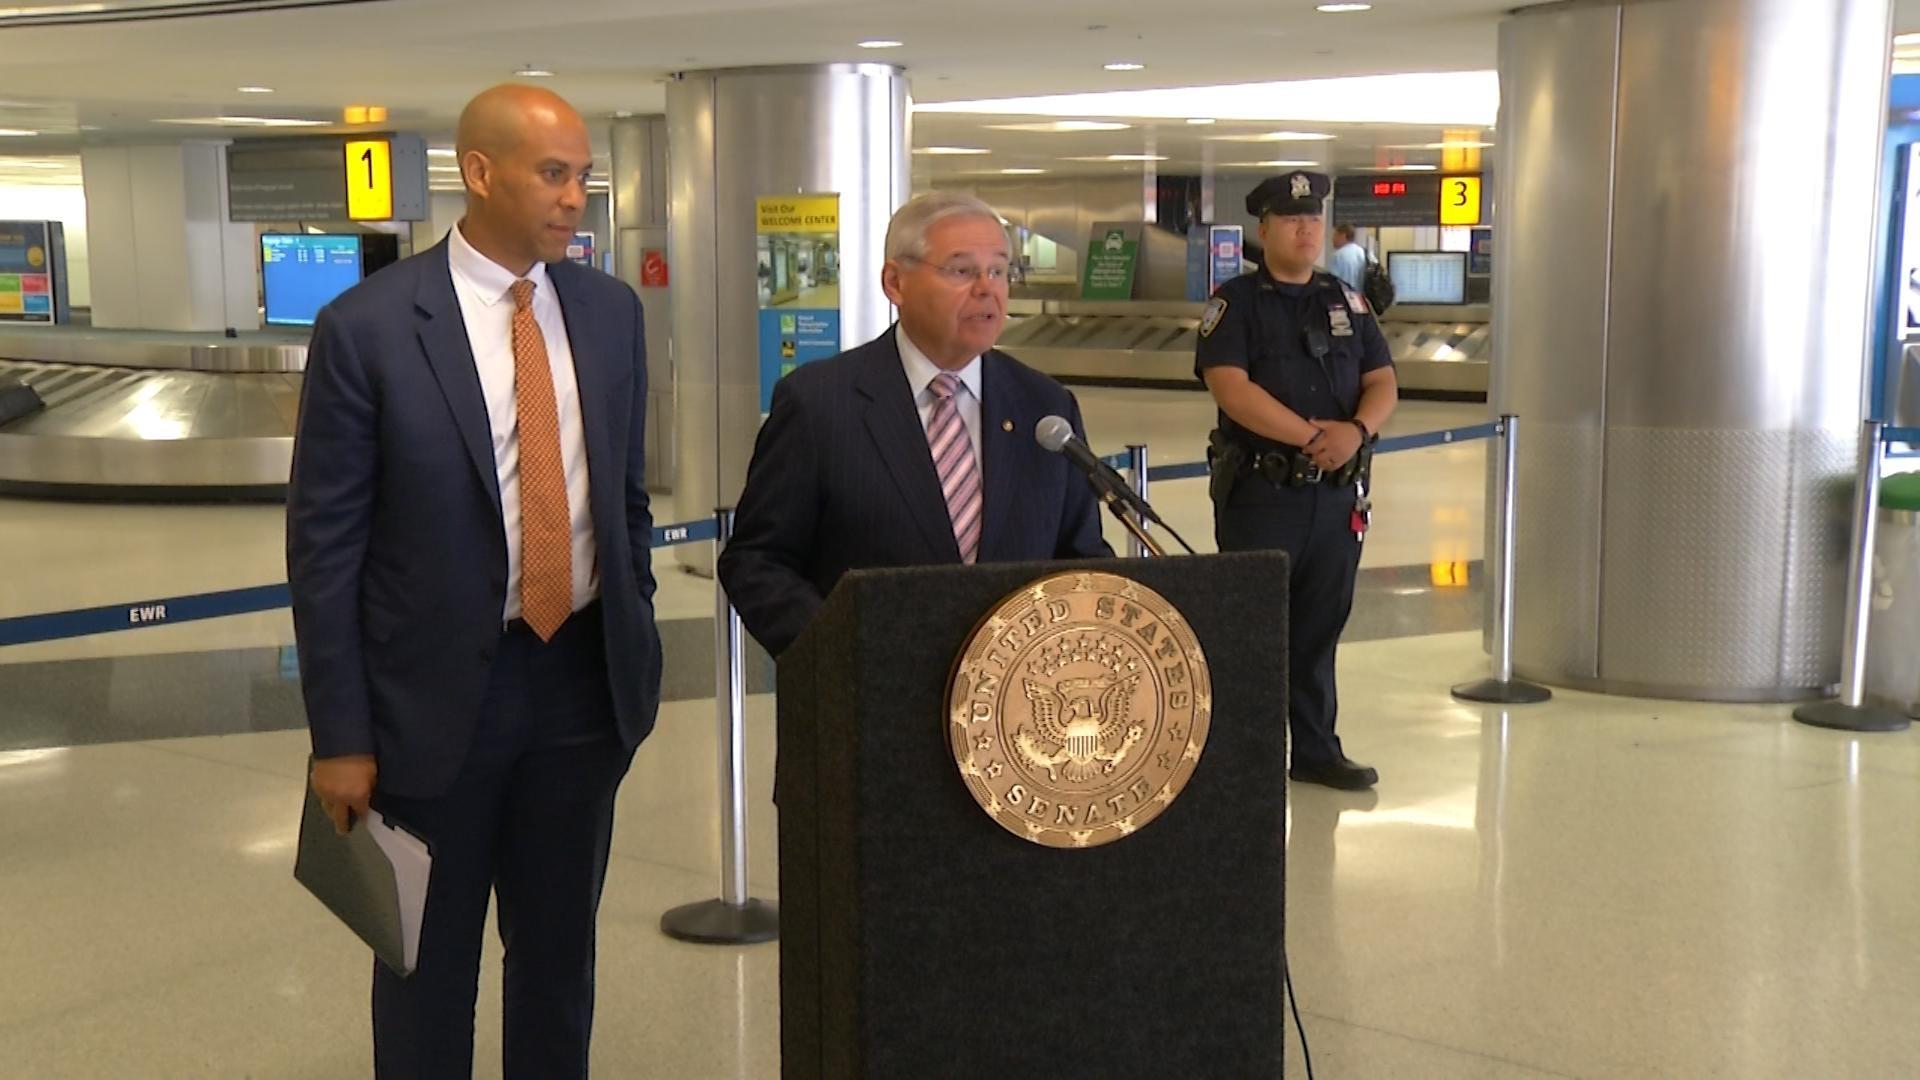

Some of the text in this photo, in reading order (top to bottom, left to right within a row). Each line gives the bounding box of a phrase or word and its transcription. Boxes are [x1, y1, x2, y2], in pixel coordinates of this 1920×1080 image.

[362, 148, 373, 189] 1
[1453, 181, 1468, 206] 3
[761, 205, 796, 214] Visit Our
[761, 215, 836, 226] WELCOME CENTER
[663, 527, 688, 542] EWR
[129, 605, 166, 622] EWR
[971, 596, 1189, 724] UNITED STATES
[1005, 776, 1152, 826] SENATE
